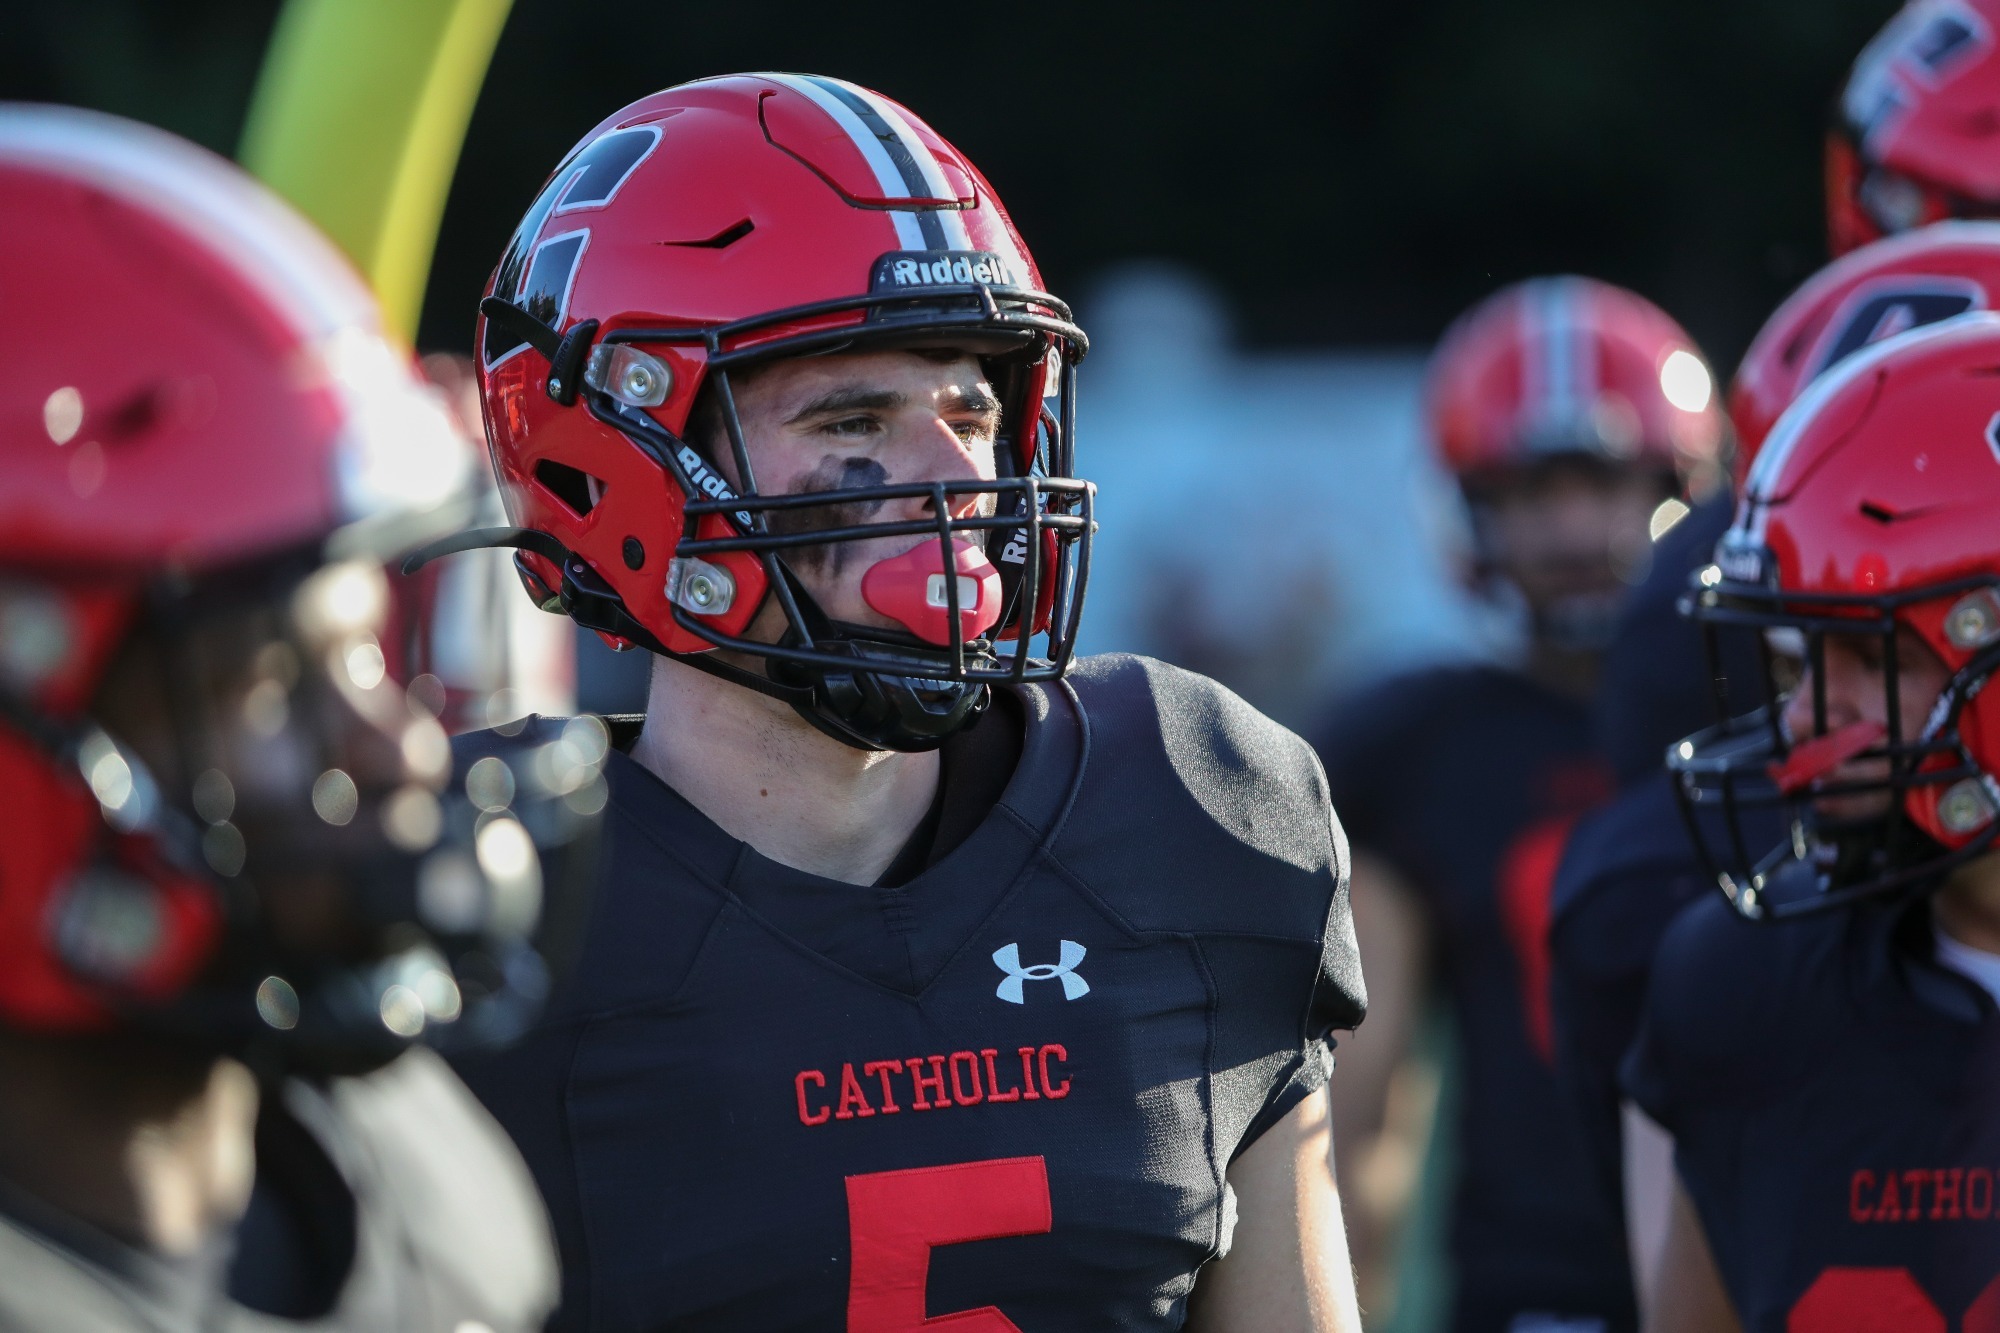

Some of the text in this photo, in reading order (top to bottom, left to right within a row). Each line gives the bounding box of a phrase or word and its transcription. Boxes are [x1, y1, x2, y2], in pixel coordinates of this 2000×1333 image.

[894, 256, 1010, 286] Riddell
[795, 1044, 1072, 1126] CATHOLIC
[1850, 1167, 2000, 1223] CATHO
